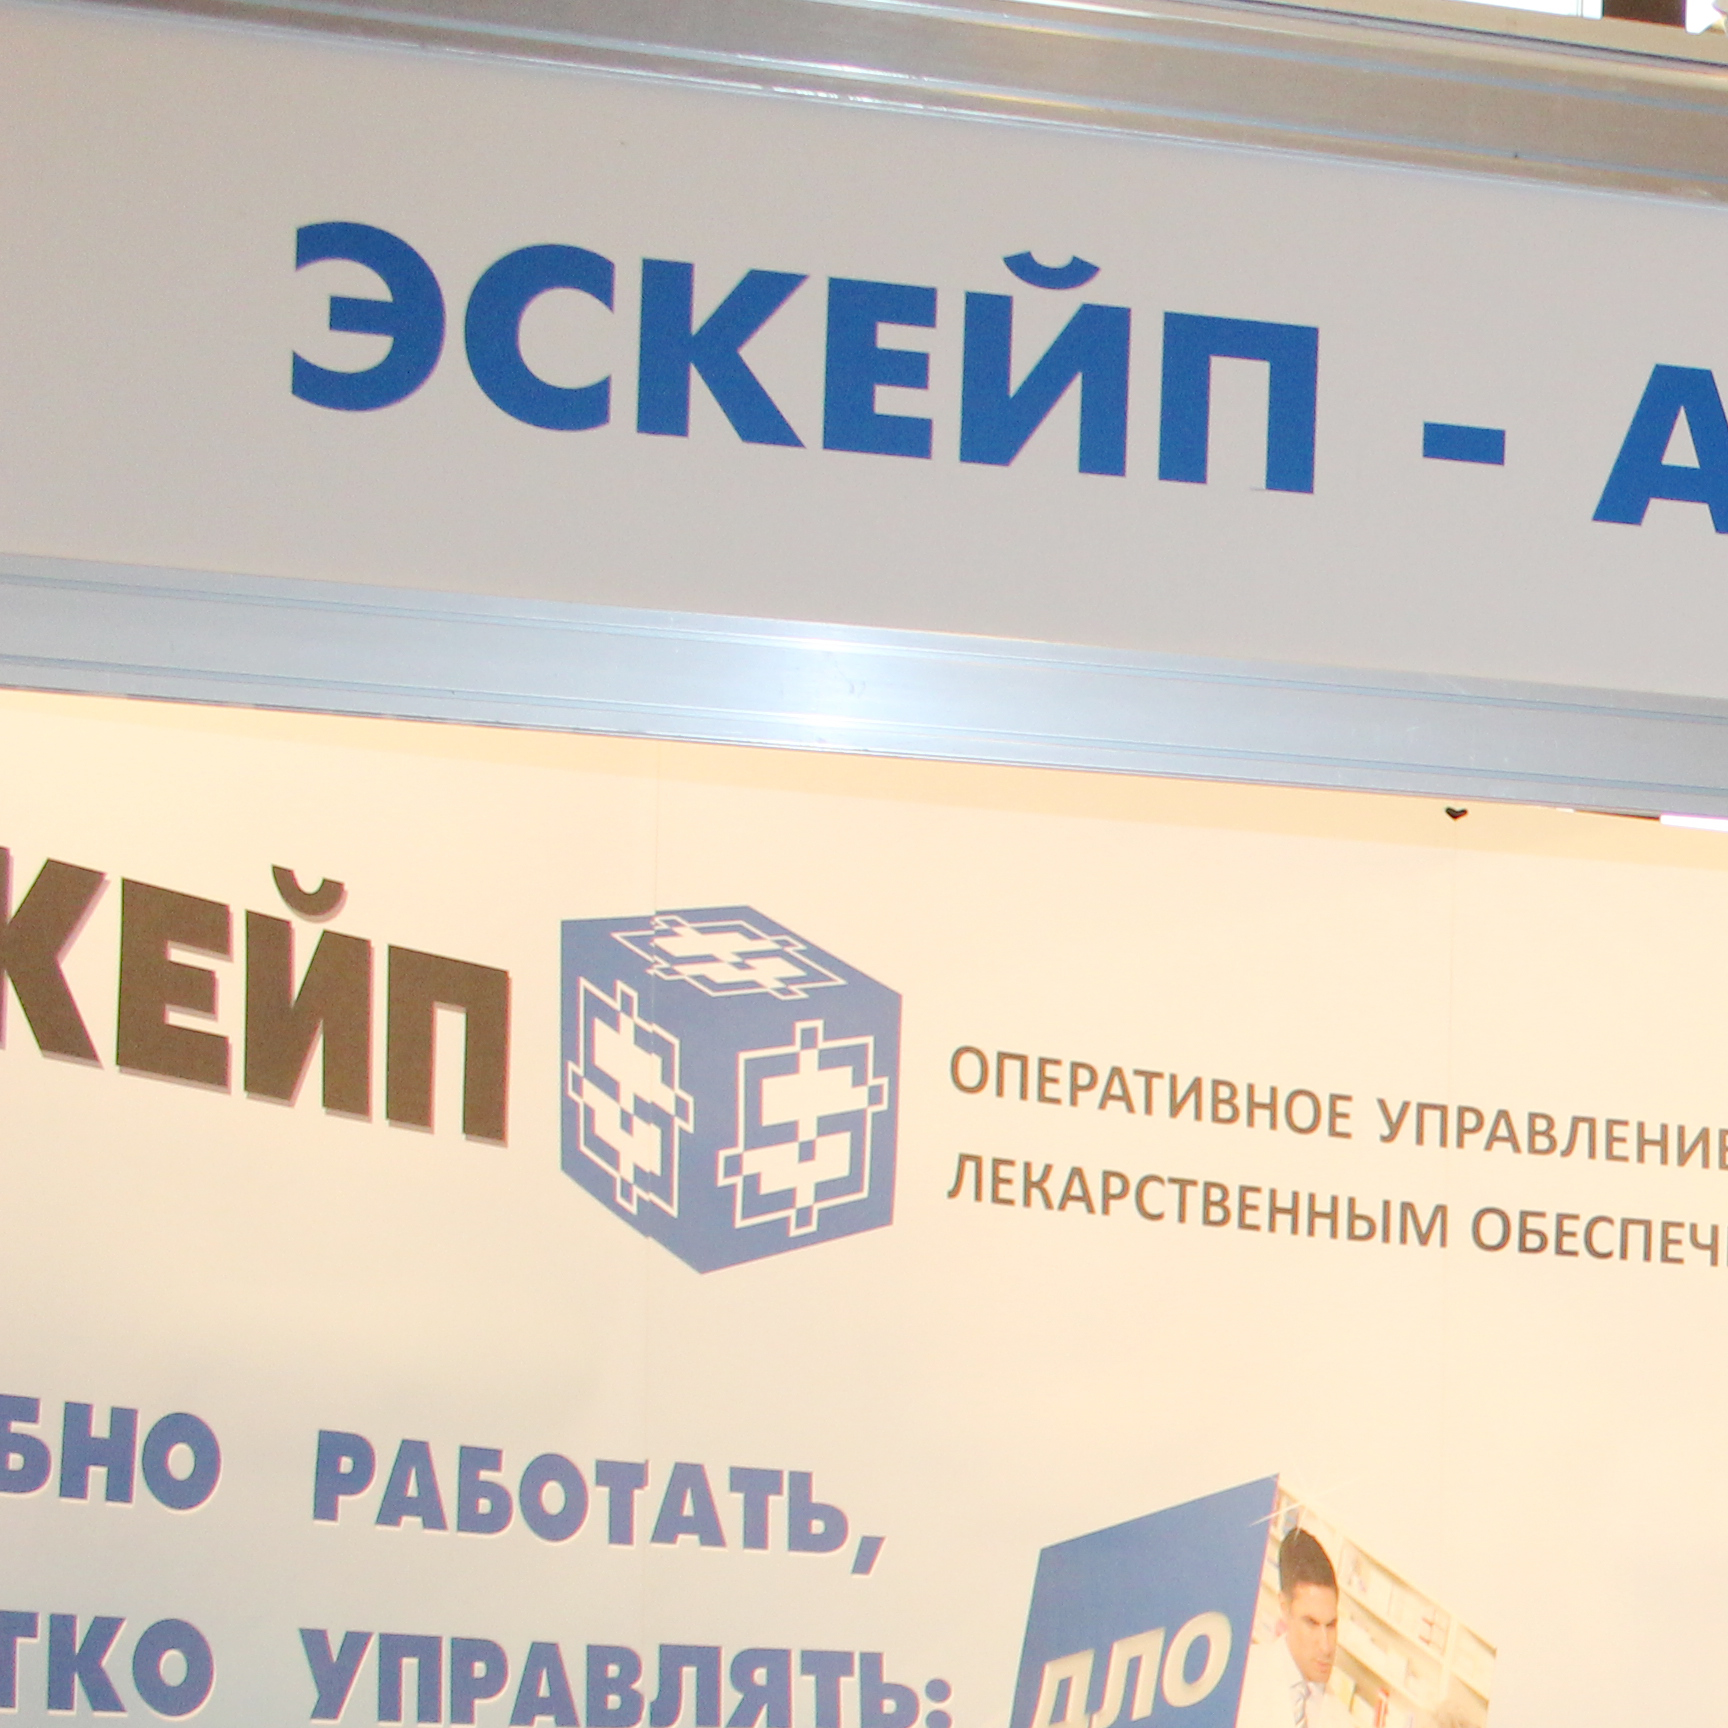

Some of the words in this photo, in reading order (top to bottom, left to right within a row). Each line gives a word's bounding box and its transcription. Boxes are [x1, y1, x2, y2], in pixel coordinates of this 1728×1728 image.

[289, 219, 1322, 494] ЭСКЕЙП
[950, 1045, 1353, 1139] ОПЕРАТИВНОЕ
[947, 1152, 1448, 1249] ЛЕКАРСТВЕННЫМ
[312, 1428, 886, 1575] РАБОТАТЬ,
